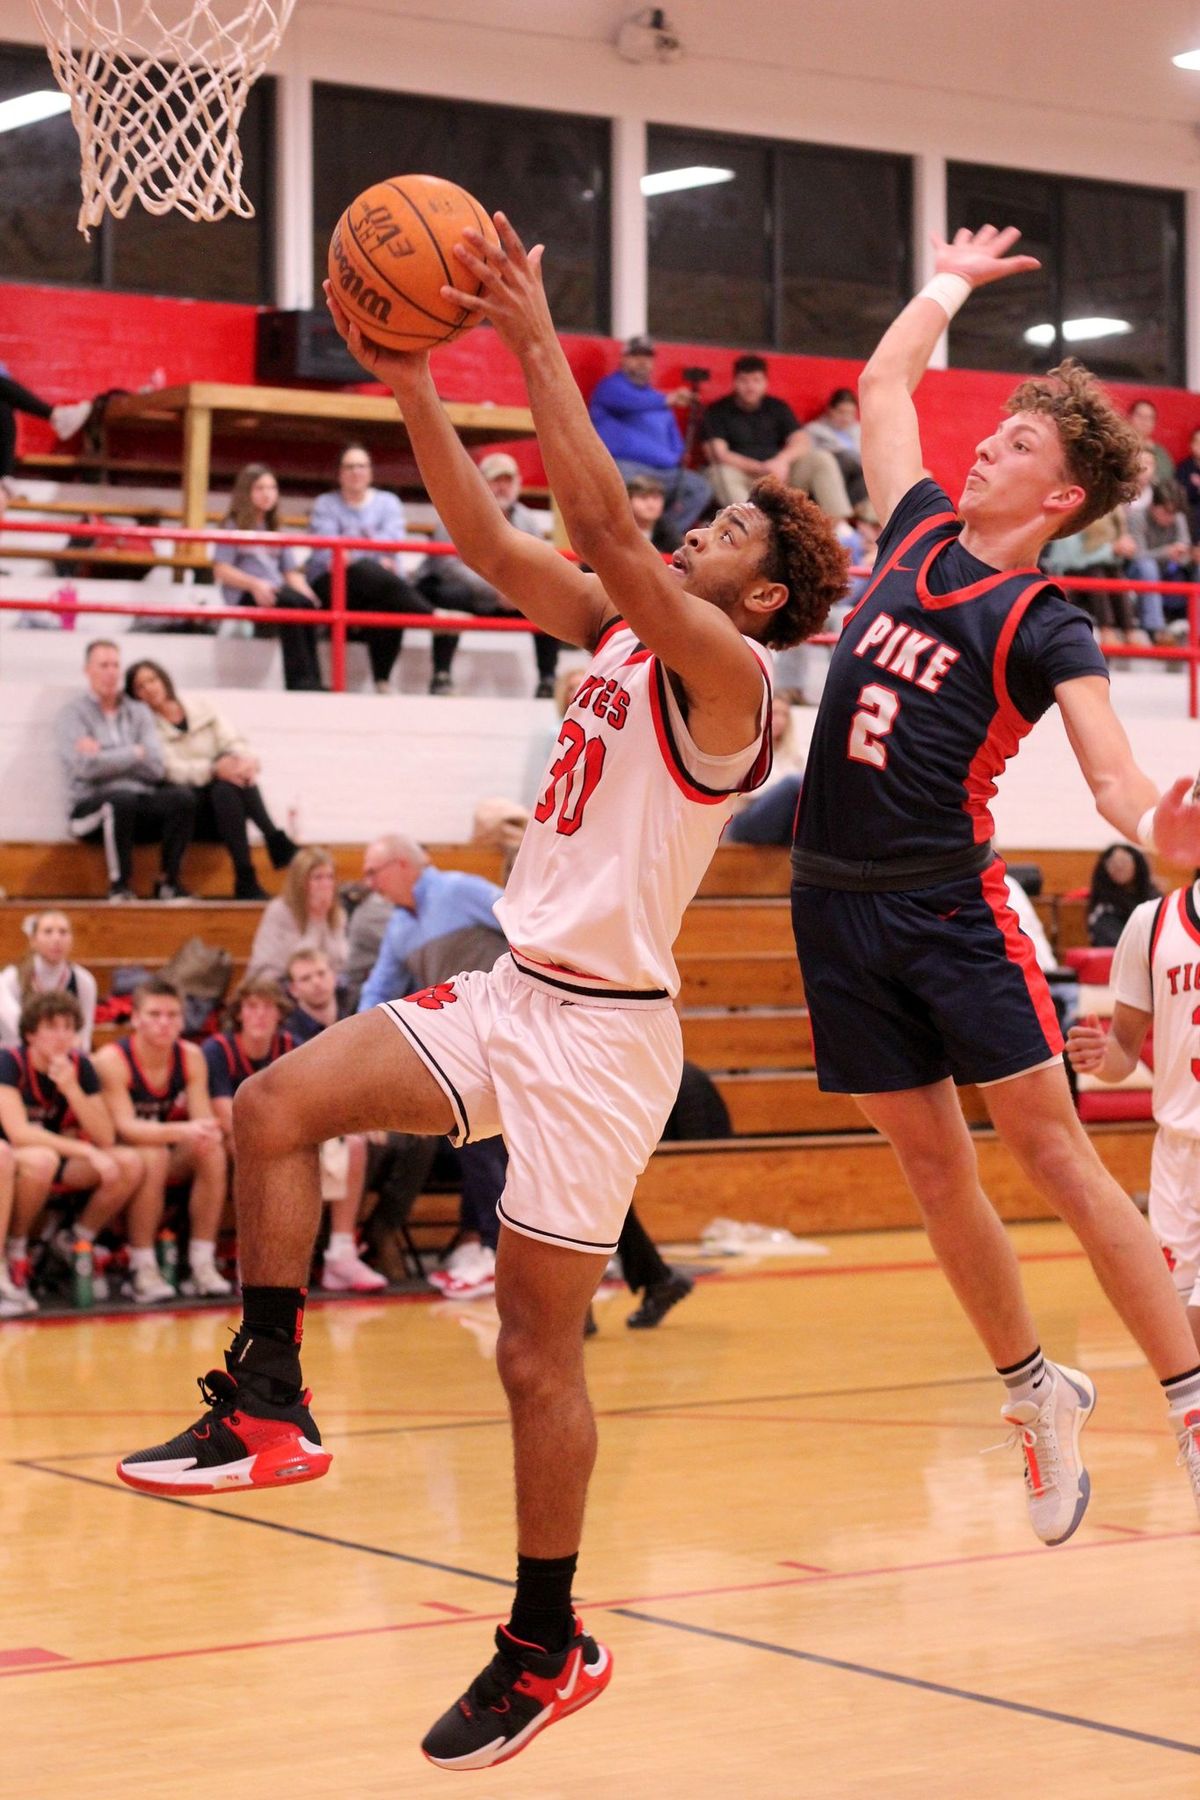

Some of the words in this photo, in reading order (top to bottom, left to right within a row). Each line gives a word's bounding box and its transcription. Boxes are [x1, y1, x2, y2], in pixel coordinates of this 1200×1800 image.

[365, 205, 416, 259] EVO
[853, 611, 961, 694] PIKE
[847, 682, 902, 771] 2
[534, 718, 607, 837] 30
